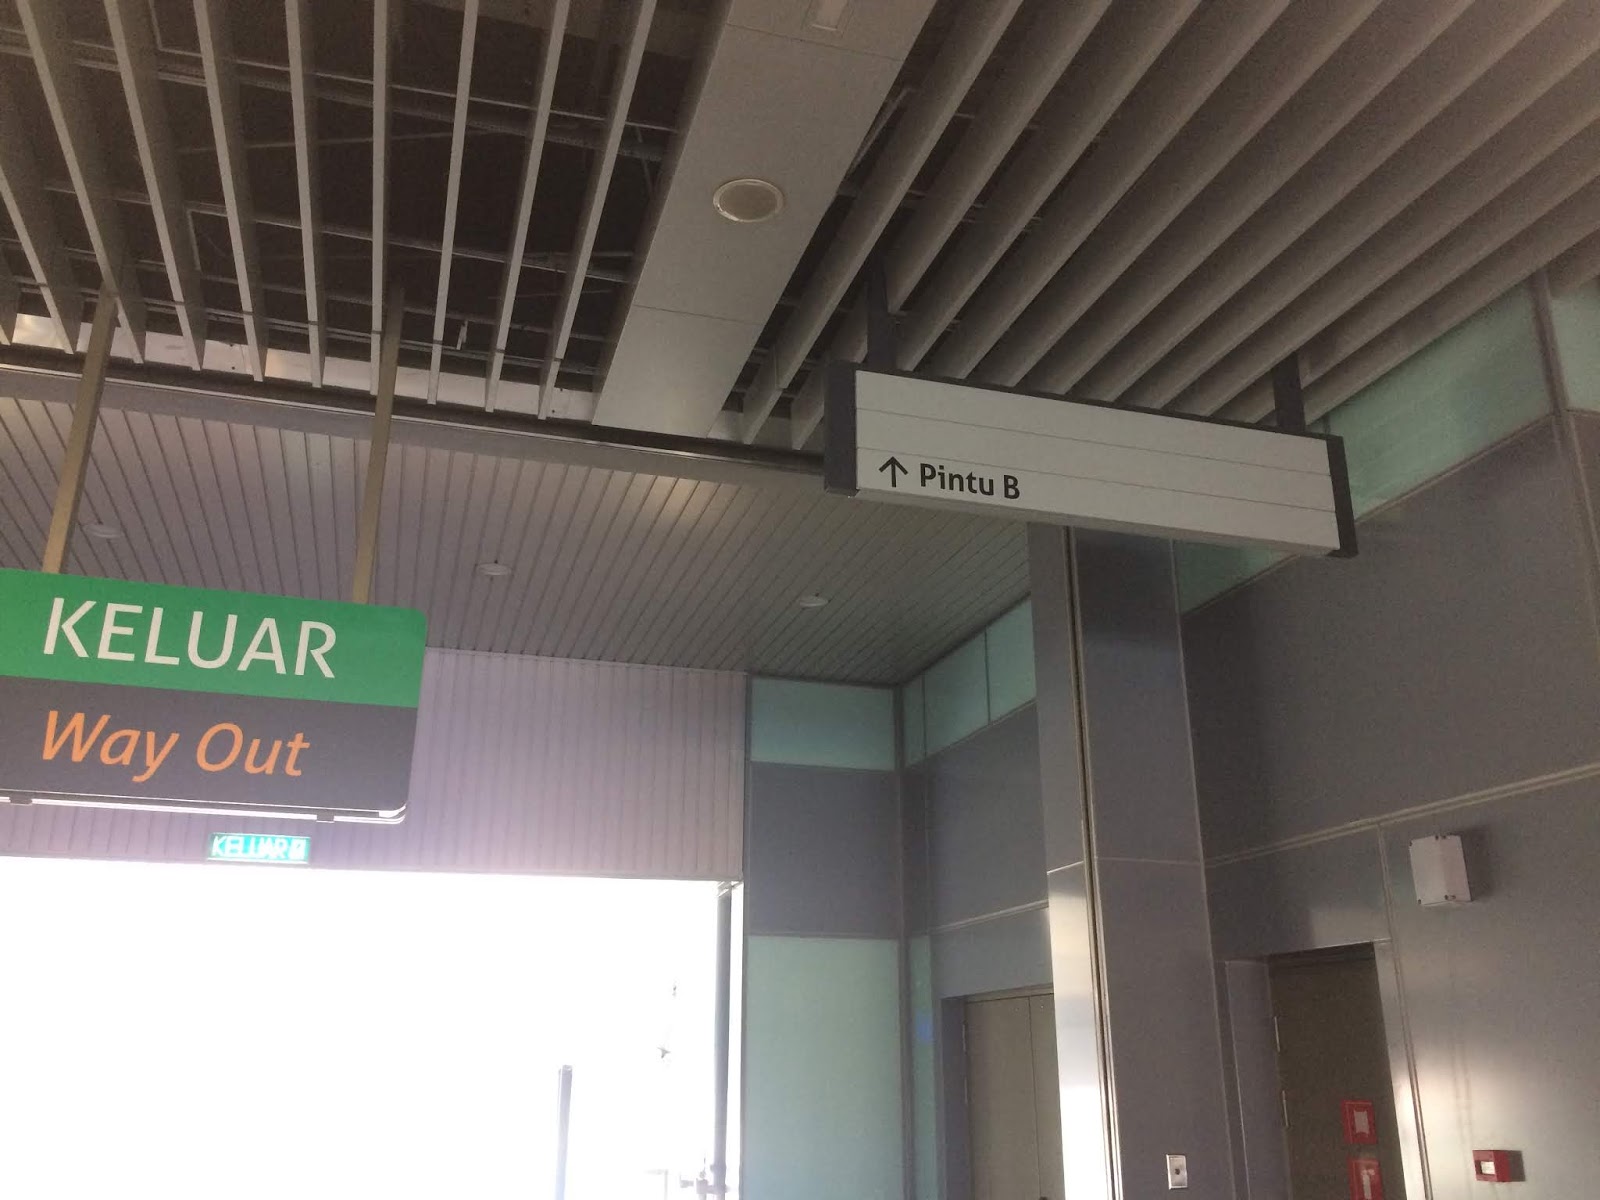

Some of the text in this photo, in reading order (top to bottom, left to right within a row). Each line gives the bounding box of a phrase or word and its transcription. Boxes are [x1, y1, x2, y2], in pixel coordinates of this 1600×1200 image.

[919, 463, 1020, 500] Pintu B
[43, 597, 337, 679] KELUAR
[41, 710, 311, 783] Way Out
[211, 835, 289, 860] KELUAR
